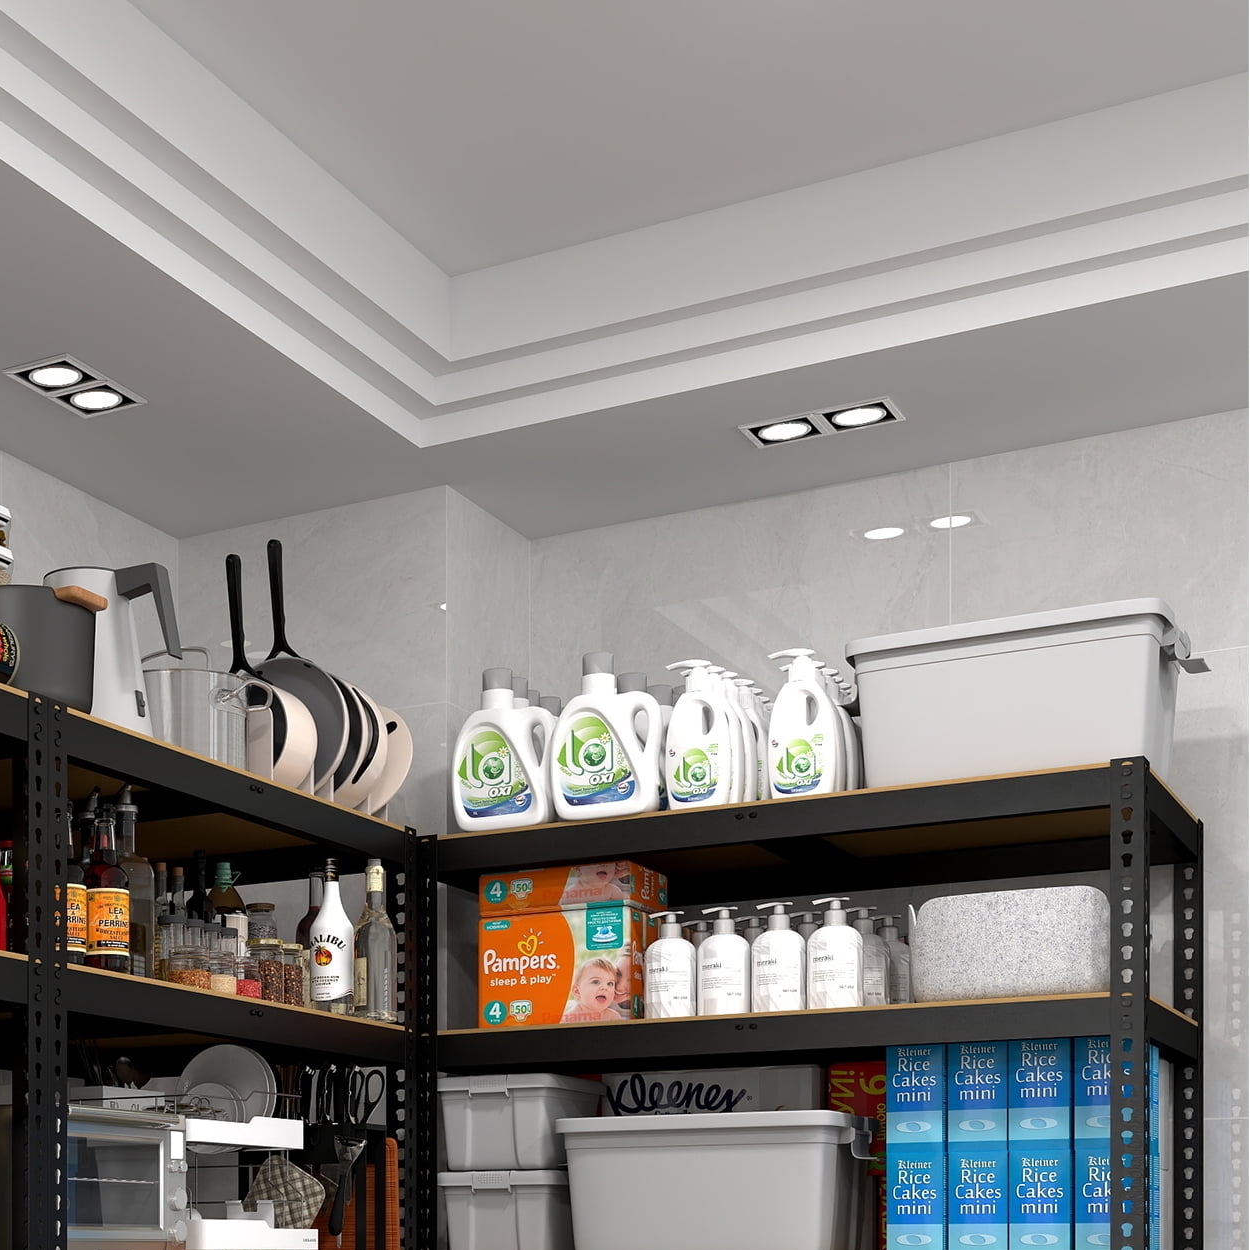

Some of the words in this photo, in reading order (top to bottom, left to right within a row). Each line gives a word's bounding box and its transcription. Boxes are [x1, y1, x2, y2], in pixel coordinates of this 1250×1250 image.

[589, 773, 615, 785] OXI
[488, 785, 513, 798] OXI
[490, 882, 502, 898] 4
[108, 907, 124, 915] LEA
[310, 934, 347, 951] MALIBU
[483, 949, 558, 974] Pampers
[490, 978, 518, 987] sleep
[519, 976, 528, 985] &
[530, 975, 552, 985] play
[490, 1002, 502, 1018] 4
[897, 1047, 932, 1057] Kleiner
[1020, 1041, 1059, 1052] Kleiner
[898, 1057, 930, 1072] Rice
[1021, 1052, 1057, 1067] Rice
[892, 1072, 937, 1087] Cakes
[1015, 1067, 1063, 1083] Cakes
[607, 1073, 747, 1115] Kleenex
[896, 1088, 931, 1102] mini
[1020, 1084, 1058, 1098] mini
[960, 1158, 997, 1168] Kleiner
[960, 1169, 996, 1183] Rice
[955, 1184, 1002, 1199] Cakes
[959, 1201, 997, 1215] mini
